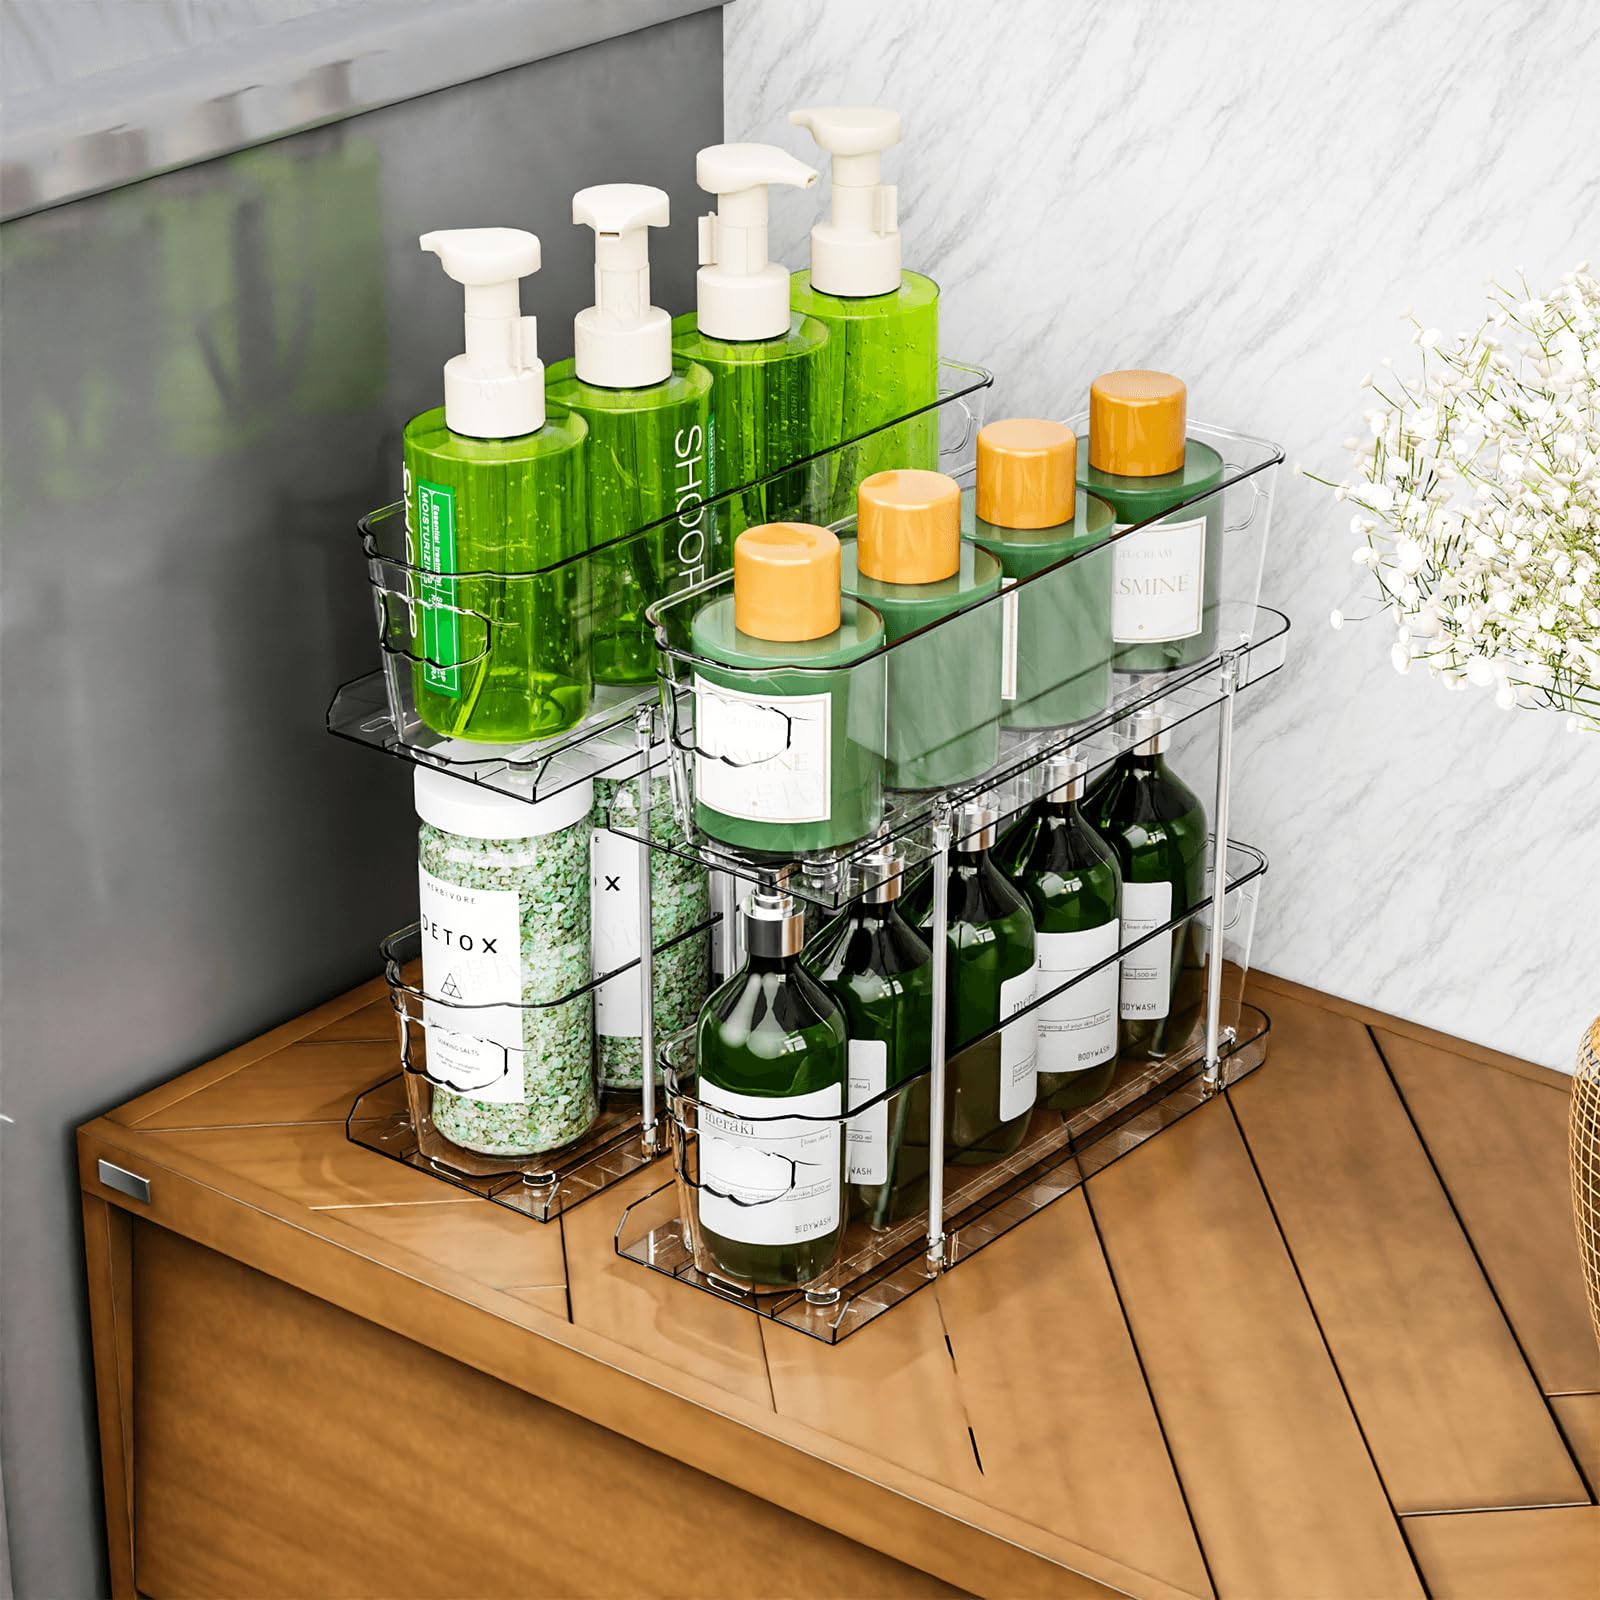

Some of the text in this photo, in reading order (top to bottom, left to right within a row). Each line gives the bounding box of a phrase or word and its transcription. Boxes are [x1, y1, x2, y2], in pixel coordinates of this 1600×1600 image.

[432, 504, 442, 544] Essential
[1119, 548, 1173, 559] EL-CREAM
[1116, 575, 1190, 596] SMINE
[426, 881, 476, 905] HERBIVORE
[422, 913, 499, 954] DETOX
[1122, 1002, 1156, 1011] ODYWASH
[459, 1047, 480, 1057] SALTS
[1077, 1045, 1111, 1062] BODYWASH
[704, 1108, 755, 1136] meraki
[795, 1216, 832, 1234] BODYWASH
